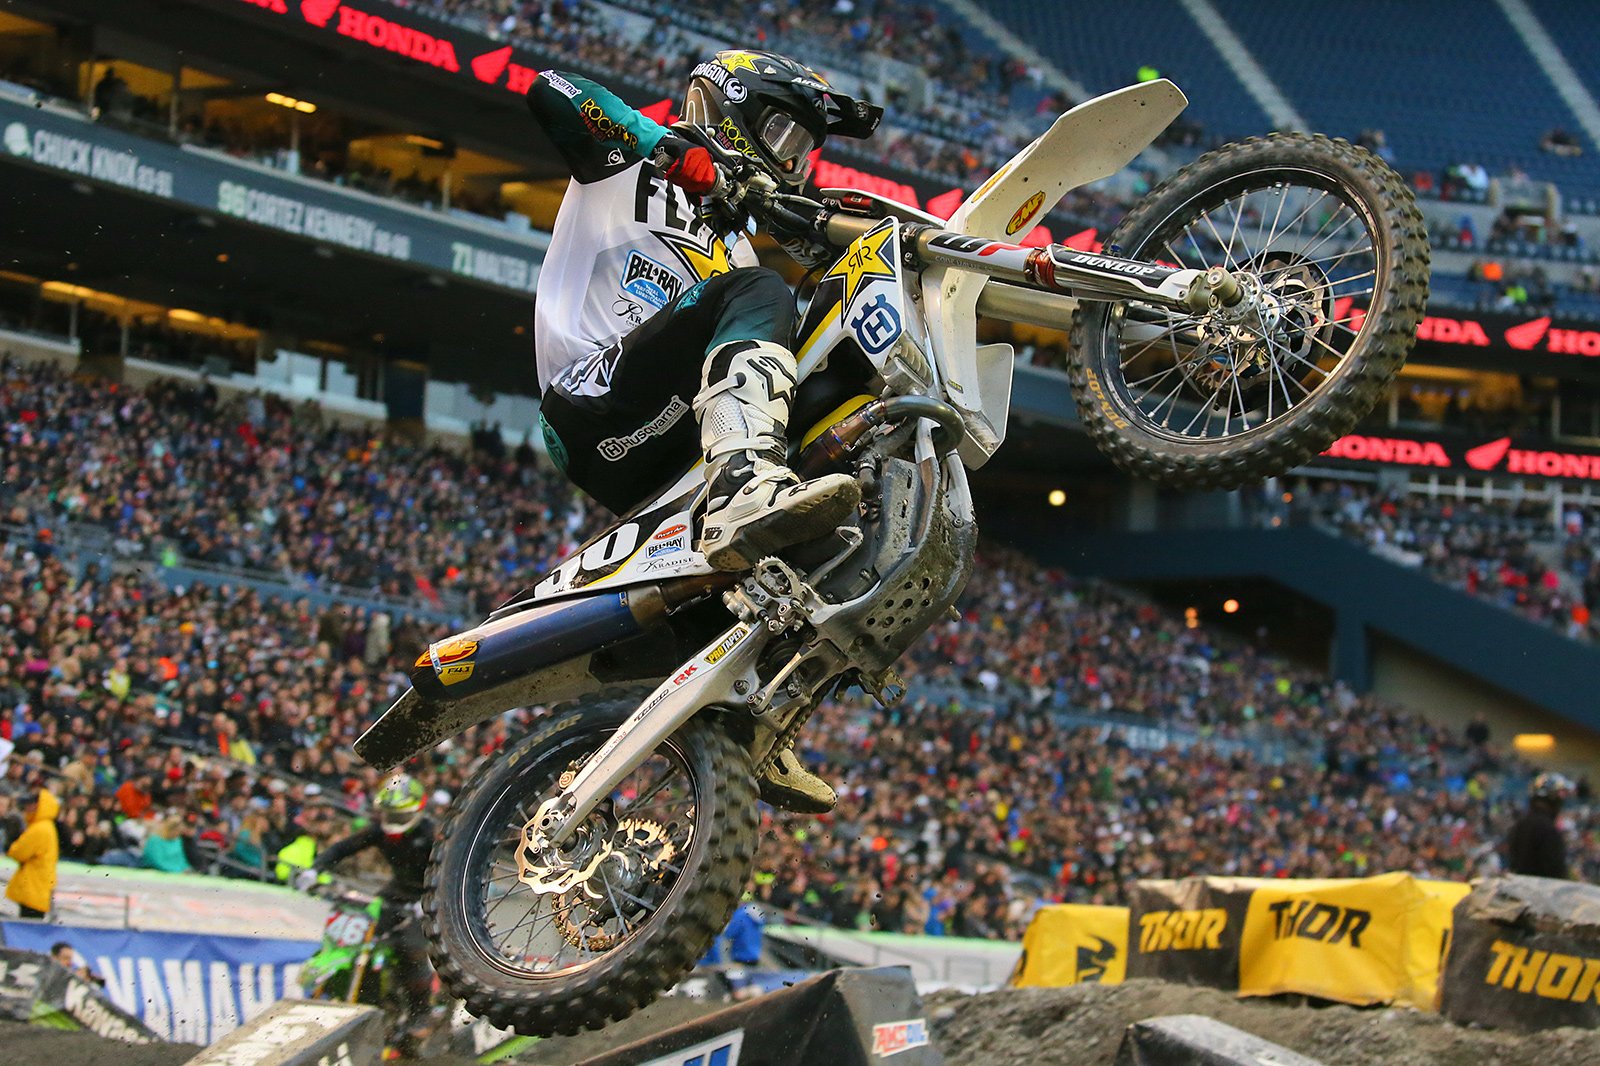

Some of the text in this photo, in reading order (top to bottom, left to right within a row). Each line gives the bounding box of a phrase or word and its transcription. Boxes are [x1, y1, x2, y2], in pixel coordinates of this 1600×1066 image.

[336, 5, 461, 73] HONDA
[690, 62, 729, 88] DRAGON
[717, 131, 736, 151] ENER
[719, 117, 760, 159] ROCK
[813, 159, 921, 210] HONDA
[1006, 190, 1046, 235] FMF
[1070, 254, 1156, 276] DUNLOP
[1416, 316, 1491, 347] NDA
[620, 401, 682, 448] Husqvarna
[1506, 448, 1600, 480] HON
[637, 557, 694, 573] PARADISE
[673, 664, 698, 686] RK
[508, 713, 583, 768] DUNLOP
[328, 914, 369, 945] 46
[1139, 908, 1228, 953] THOR
[1268, 901, 1371, 949] THOR
[1485, 940, 1600, 1007] THOR
[875, 1022, 925, 1053] AMSOIL
